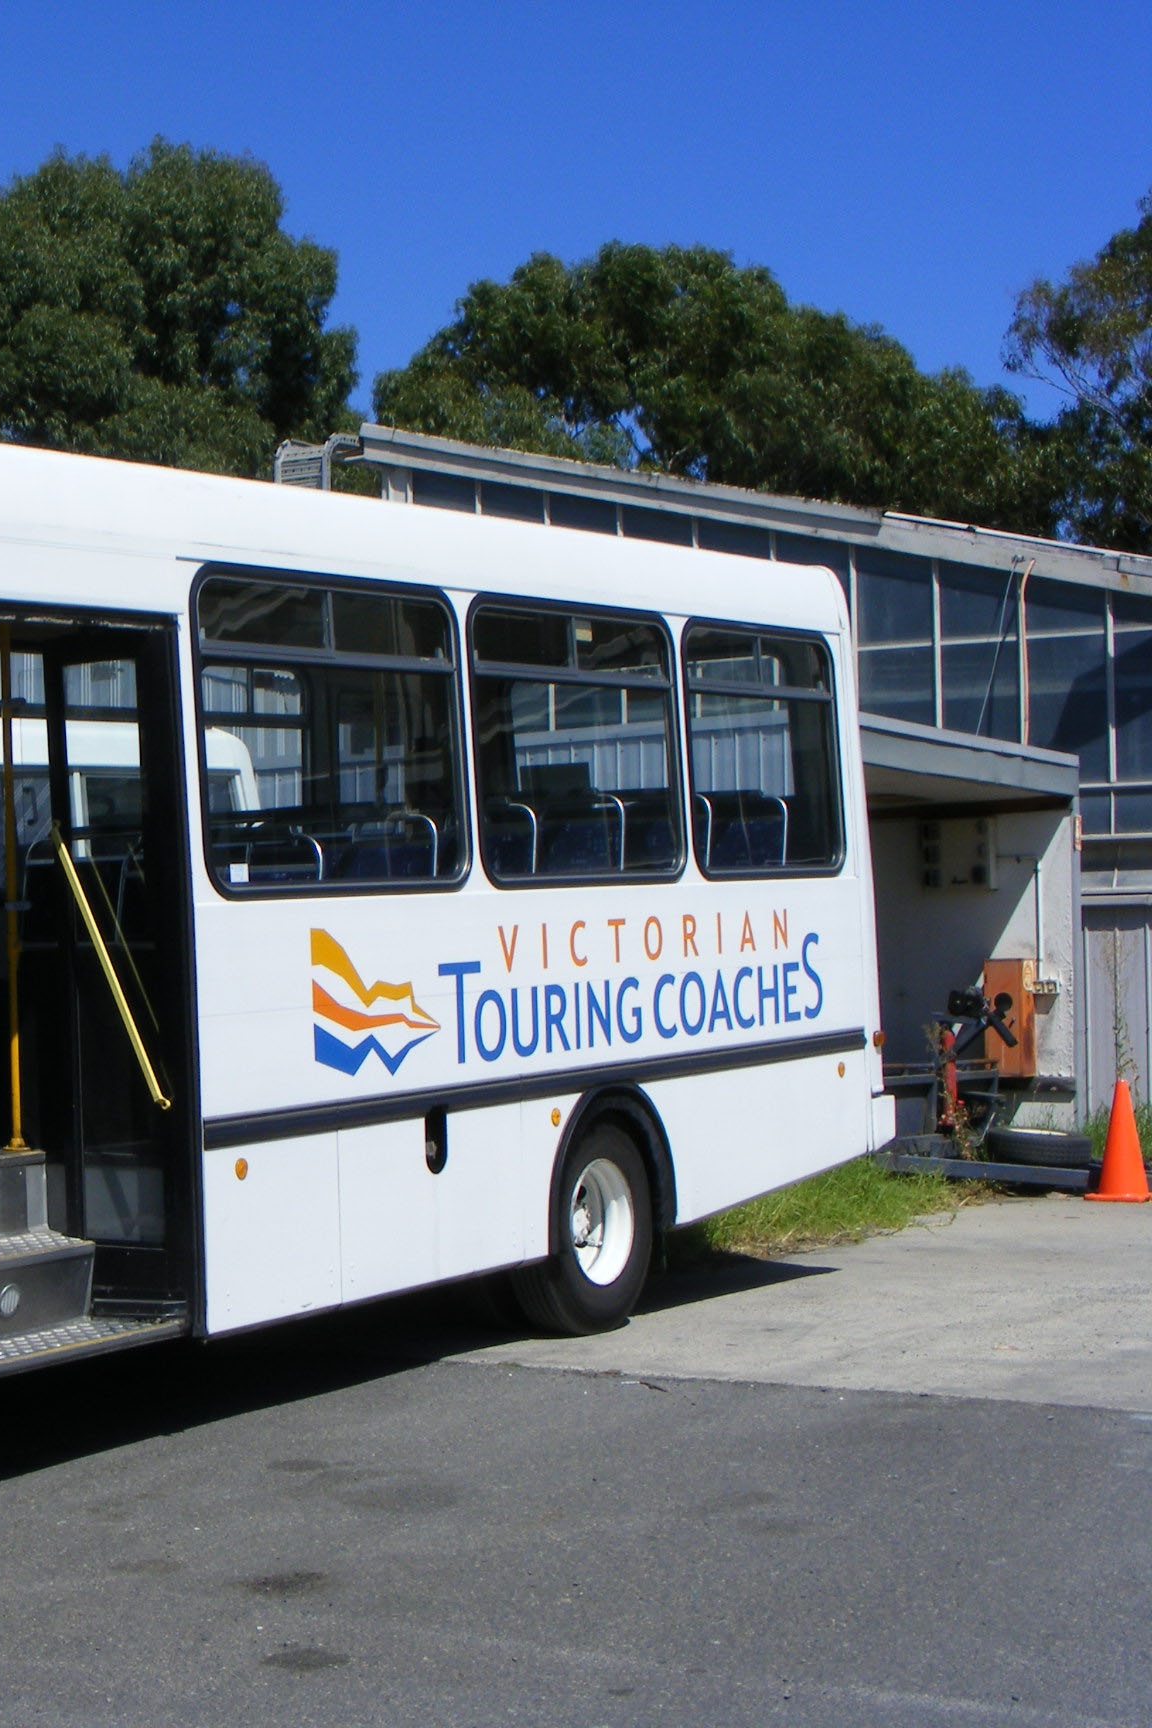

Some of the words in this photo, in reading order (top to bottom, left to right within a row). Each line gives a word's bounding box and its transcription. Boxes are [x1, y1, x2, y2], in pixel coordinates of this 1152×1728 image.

[497, 908, 789, 973] VICTORIAN
[437, 960, 642, 1065] TOURING
[652, 932, 823, 1039] COACHES
